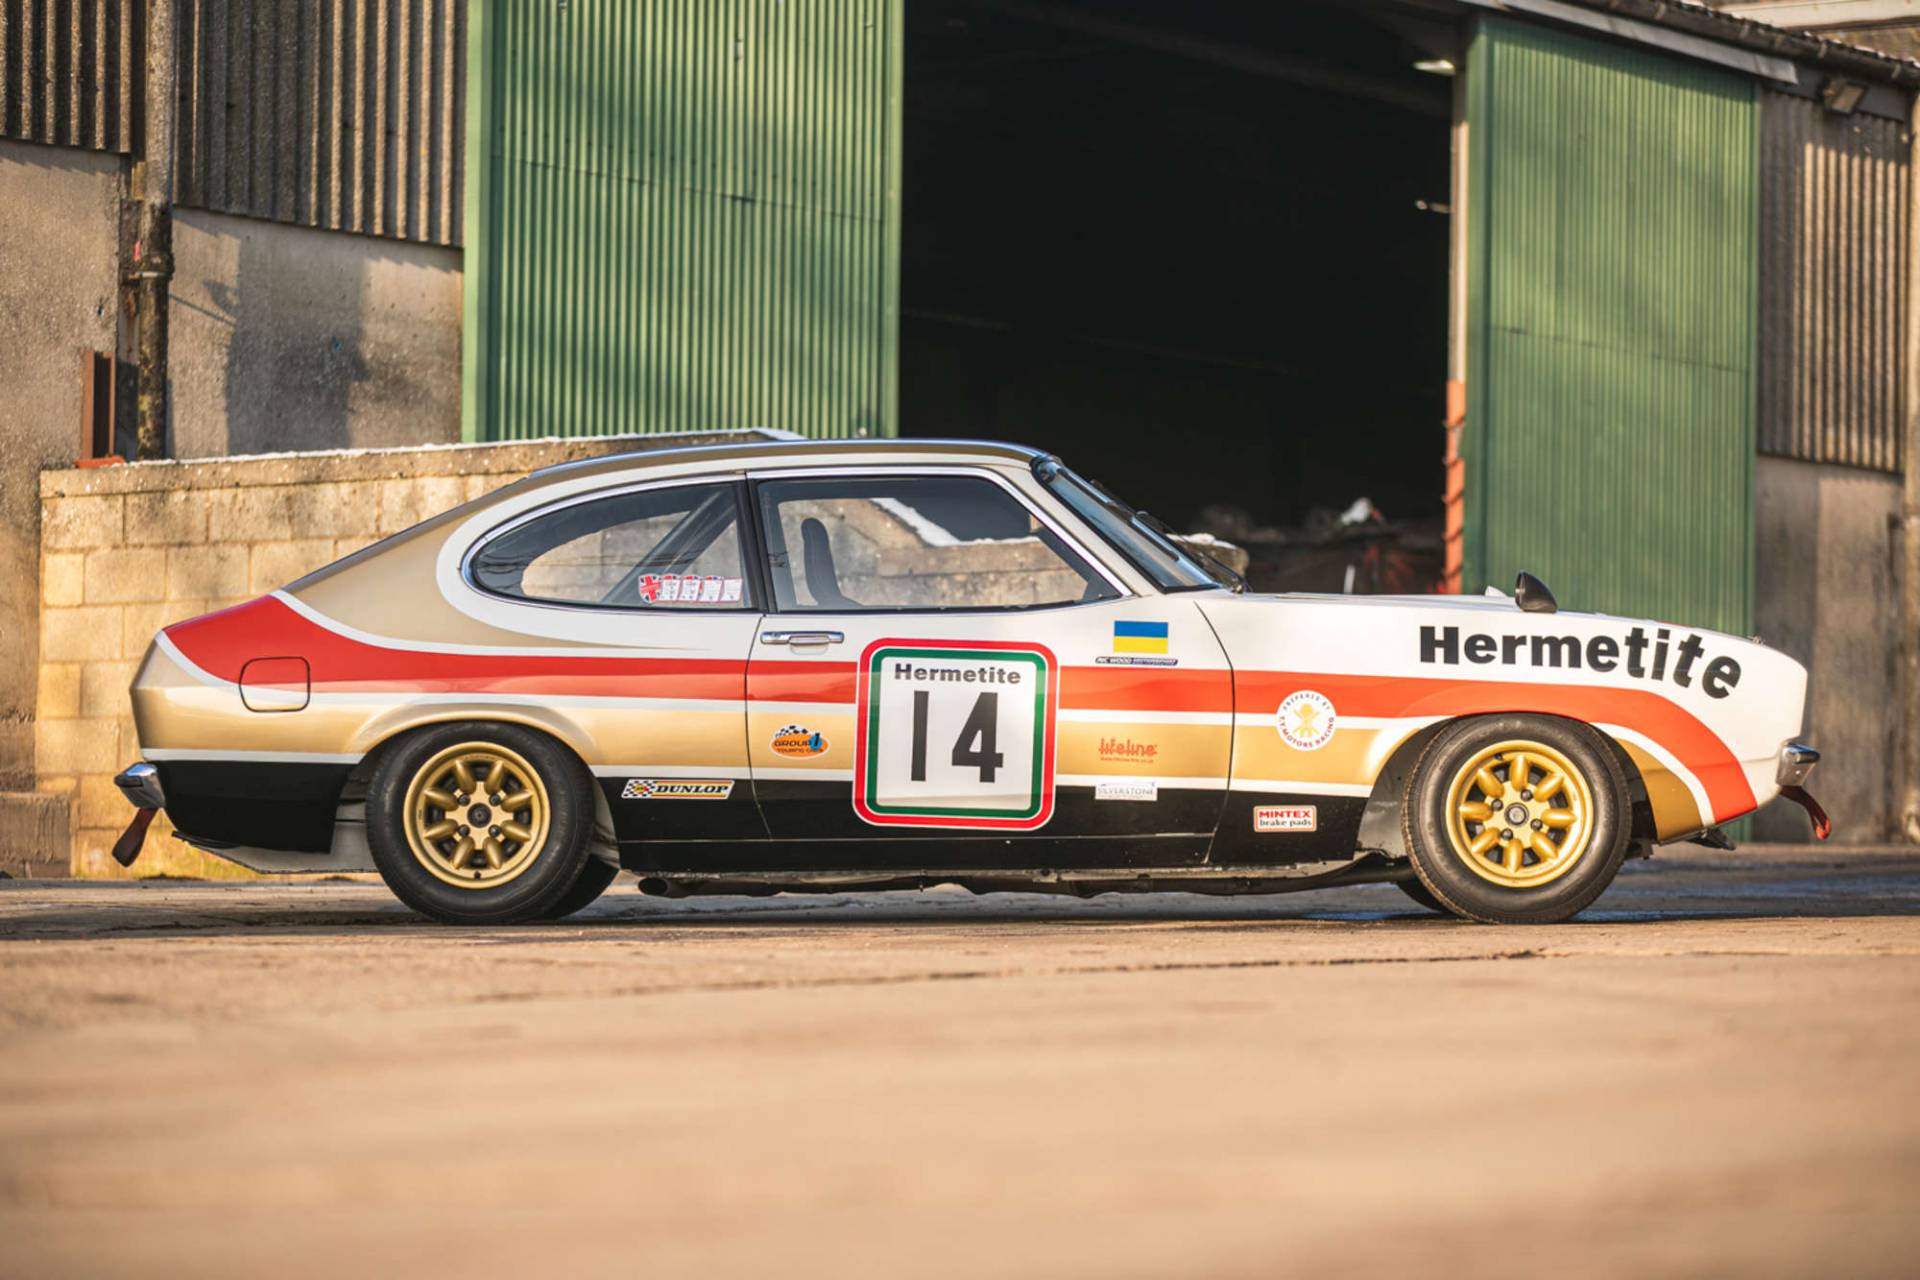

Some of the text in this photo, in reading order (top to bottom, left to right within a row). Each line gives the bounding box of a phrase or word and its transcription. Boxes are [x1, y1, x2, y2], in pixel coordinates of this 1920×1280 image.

[1419, 625, 1742, 699] Hermetite
[894, 663, 1021, 684] Hermetite
[911, 690, 1004, 783] 14
[1315, 716, 1335, 746] RACING
[1098, 737, 1157, 757] lifeline
[656, 784, 729, 794] DUNLOP
[1259, 810, 1311, 818] MINTEX
[1290, 819, 1312, 828] pads
